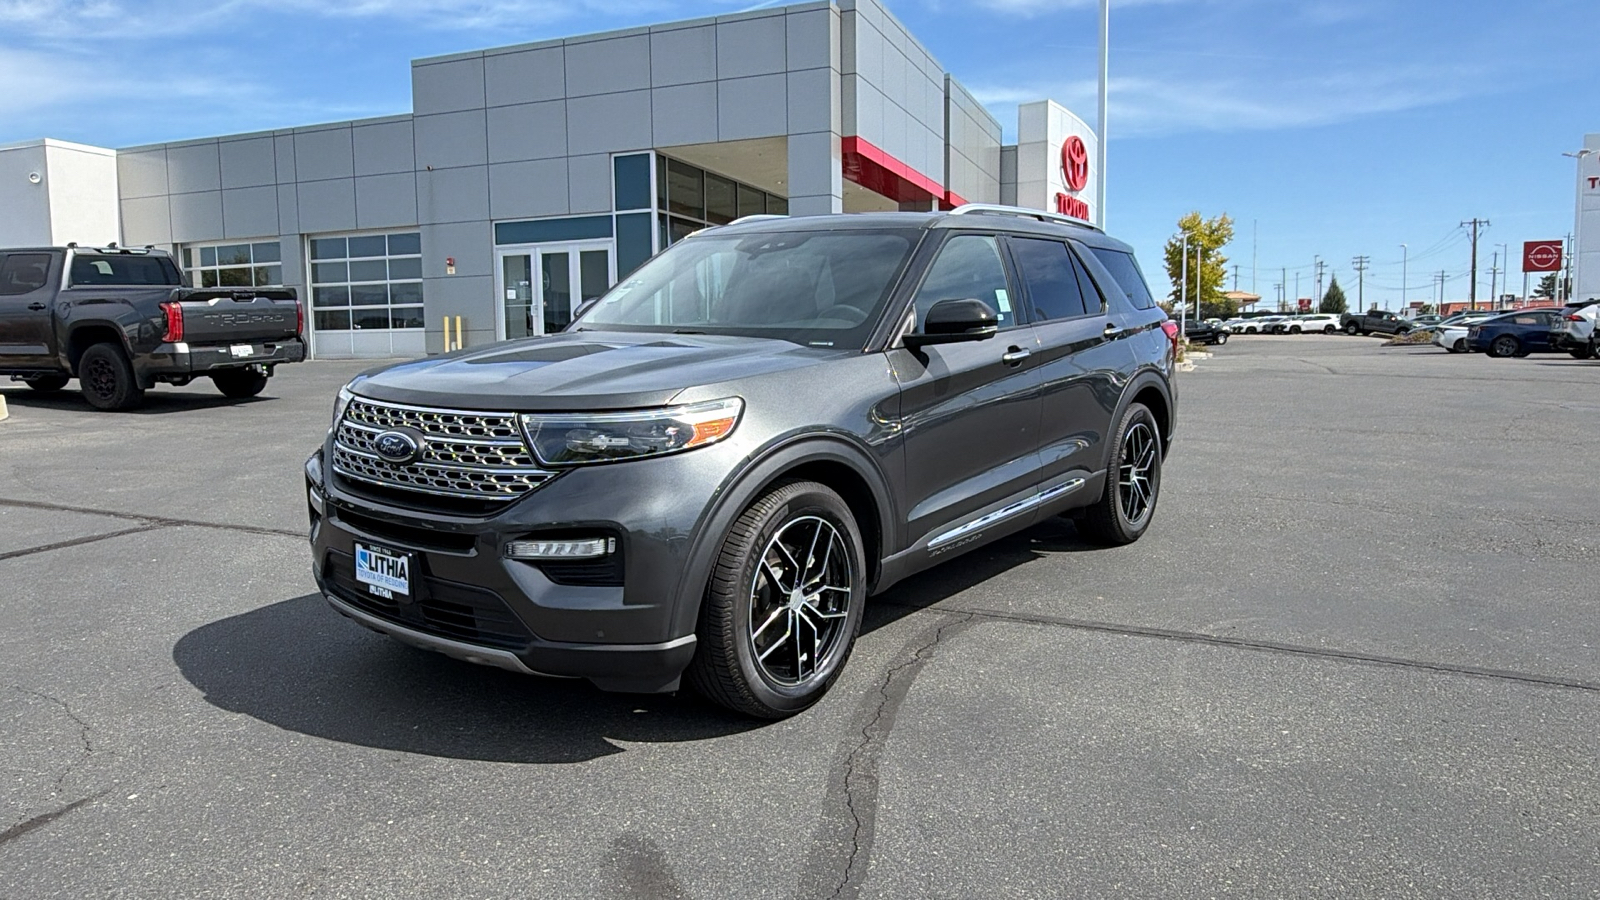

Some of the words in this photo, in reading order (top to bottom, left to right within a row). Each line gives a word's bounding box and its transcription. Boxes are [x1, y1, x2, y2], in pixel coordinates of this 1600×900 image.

[1056, 192, 1089, 221] TOYOTA
[204, 314, 250, 327] TRD
[381, 436, 404, 455] Ford
[368, 552, 408, 581] LITHIA
[358, 569, 376, 579] TOYOTA
[376, 574, 383, 582] OF
[384, 575, 408, 590] REDDING
[373, 584, 393, 600] LITHIA
